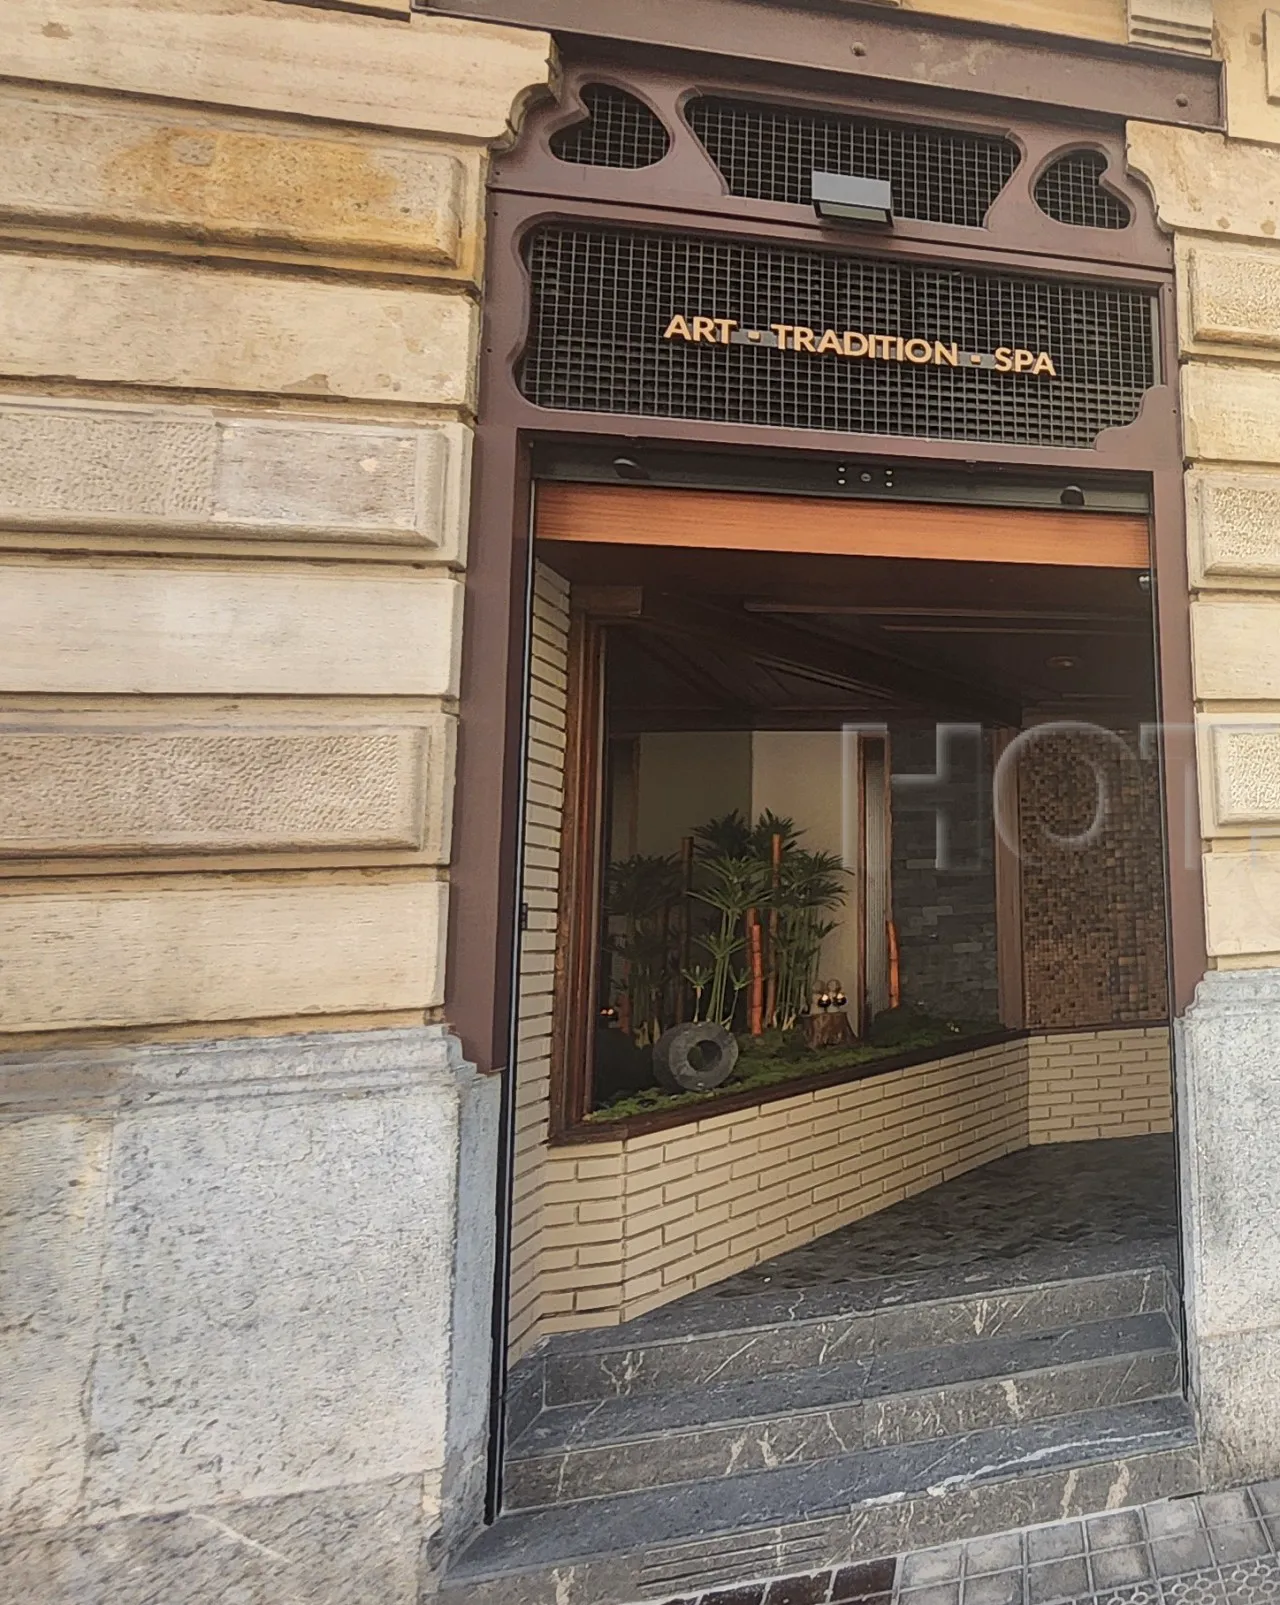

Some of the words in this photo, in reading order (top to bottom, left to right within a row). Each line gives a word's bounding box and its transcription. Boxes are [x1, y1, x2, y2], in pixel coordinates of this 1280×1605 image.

[663, 314, 737, 344] ART
[771, 323, 958, 366] TRADITION
[994, 346, 1056, 376] SPA
